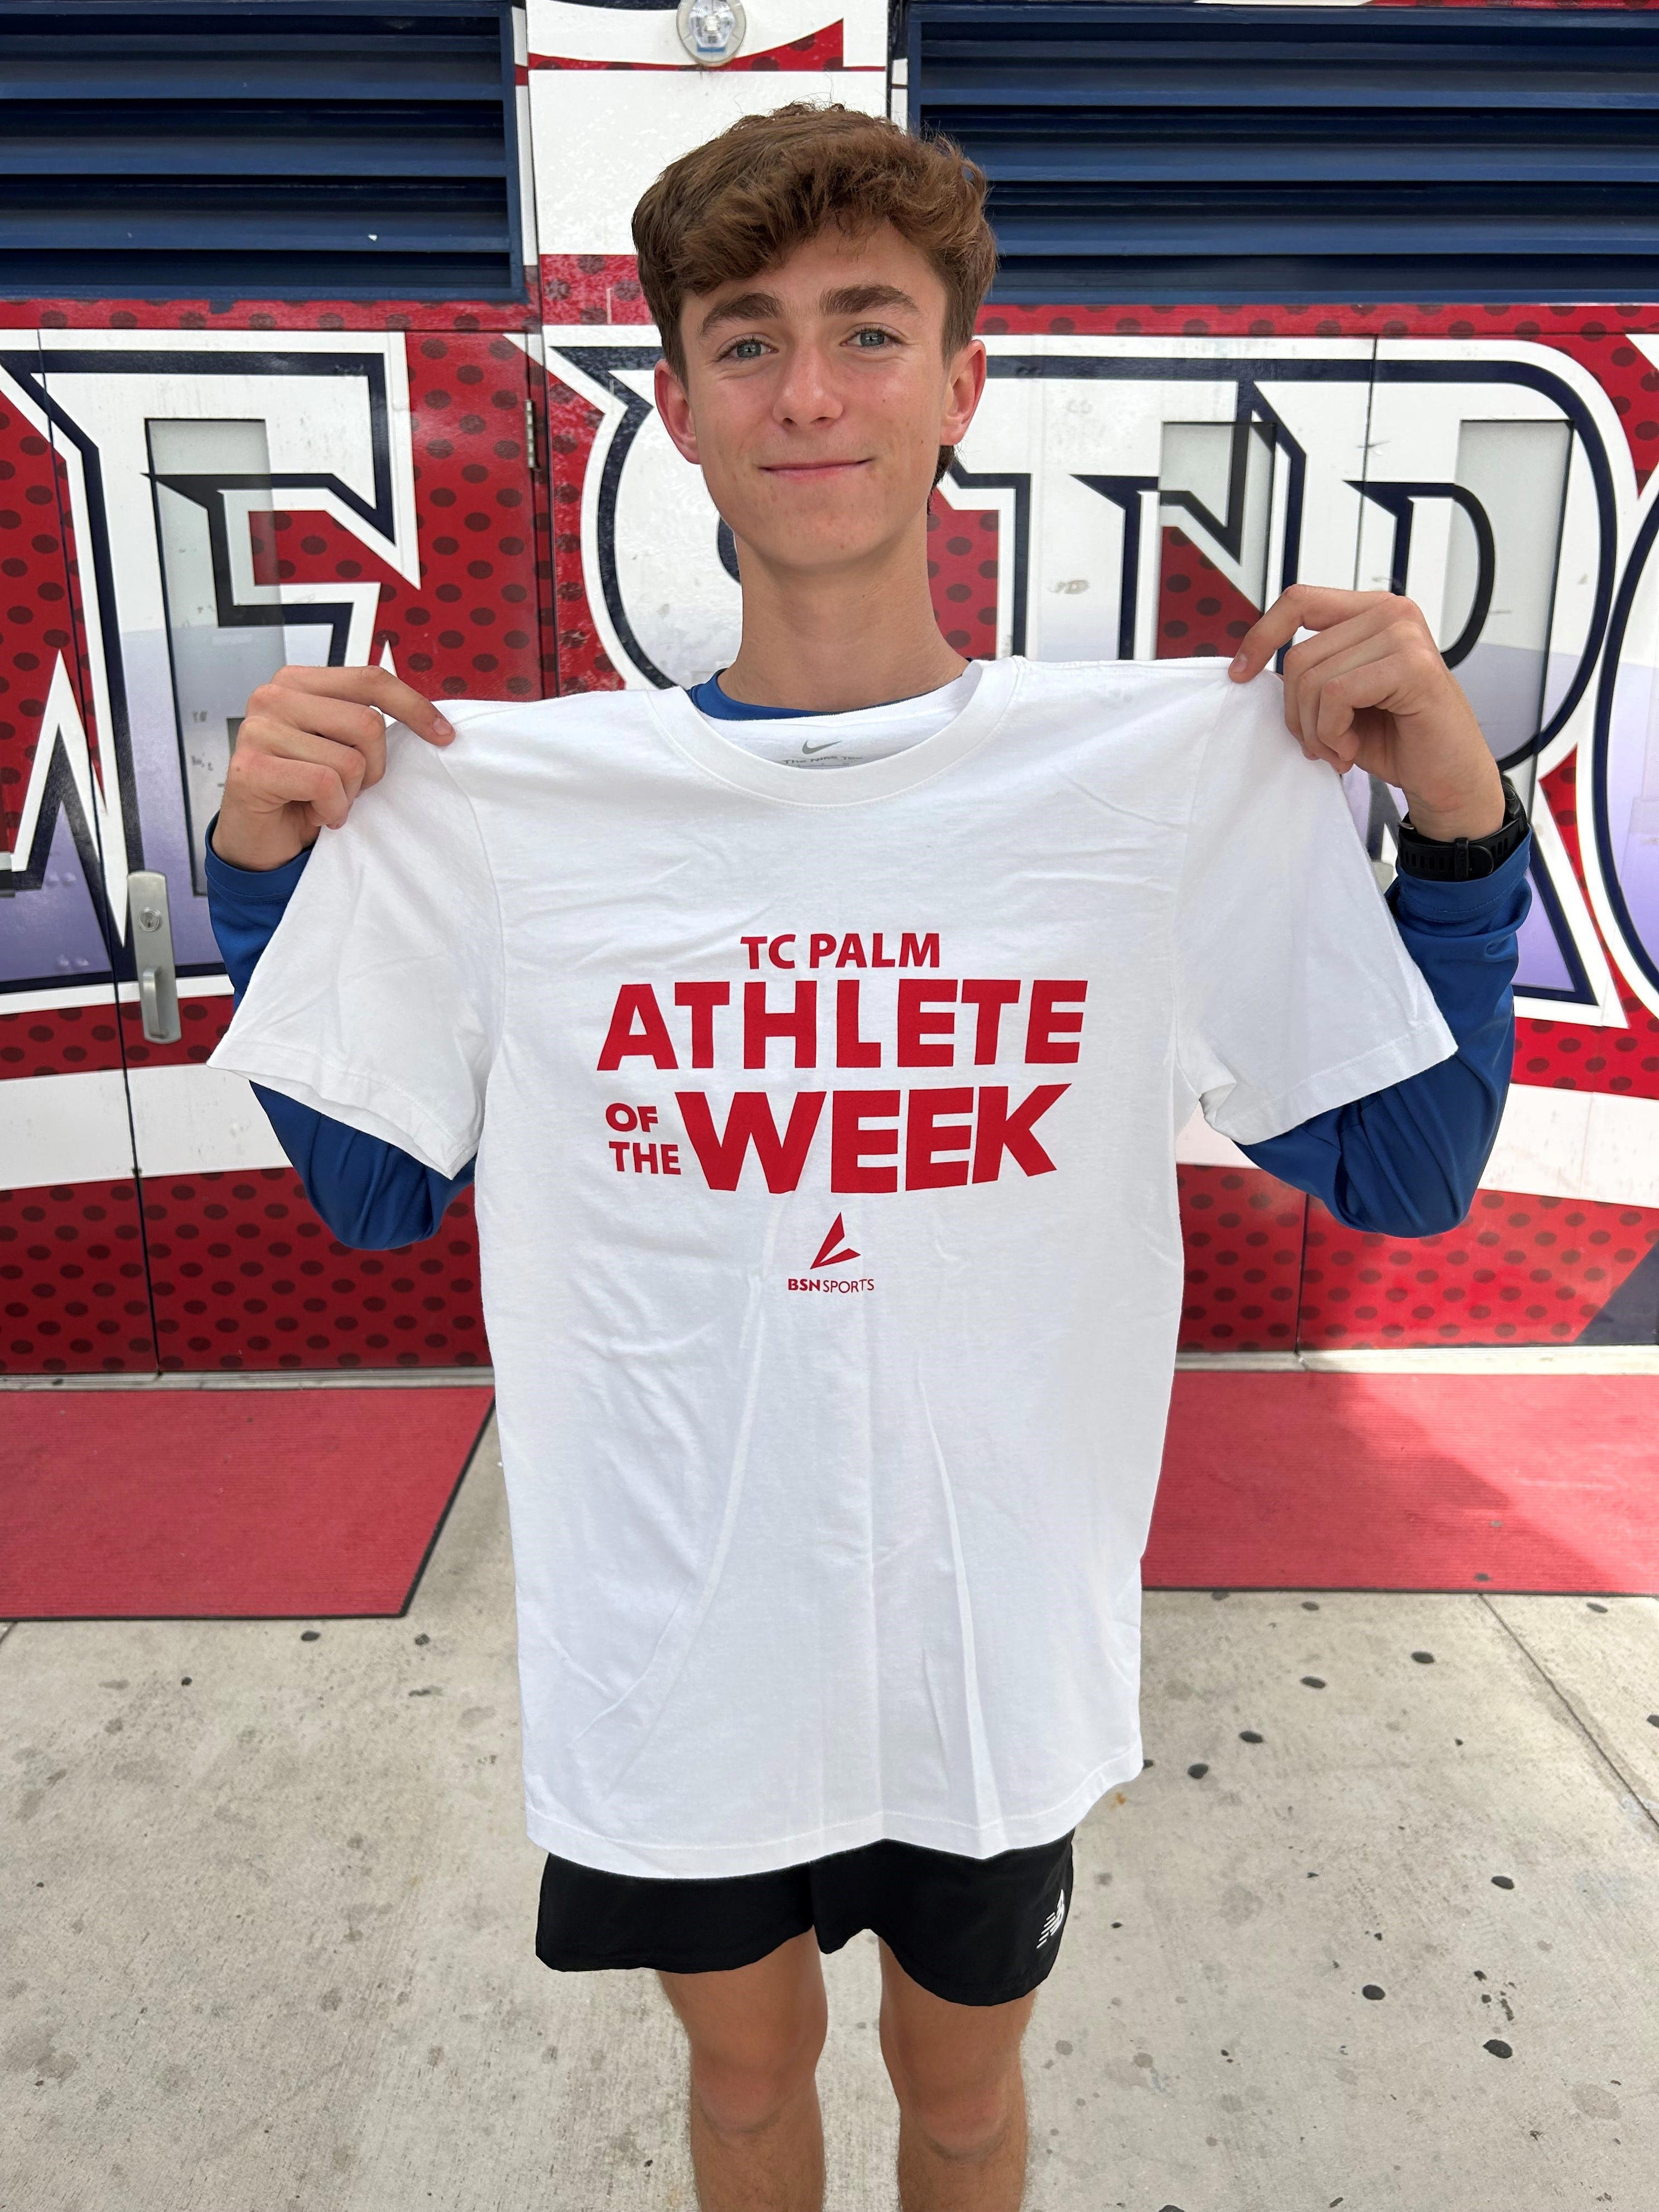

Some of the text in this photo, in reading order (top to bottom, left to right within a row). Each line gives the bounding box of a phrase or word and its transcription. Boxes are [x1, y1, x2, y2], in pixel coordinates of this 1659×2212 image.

[741, 933, 940, 969] TC PALM
[597, 979, 1087, 1070] ATHLETE
[606, 1103, 658, 1132] OF
[675, 1084, 1072, 1194] WEEK
[609, 1142, 681, 1175] THE
